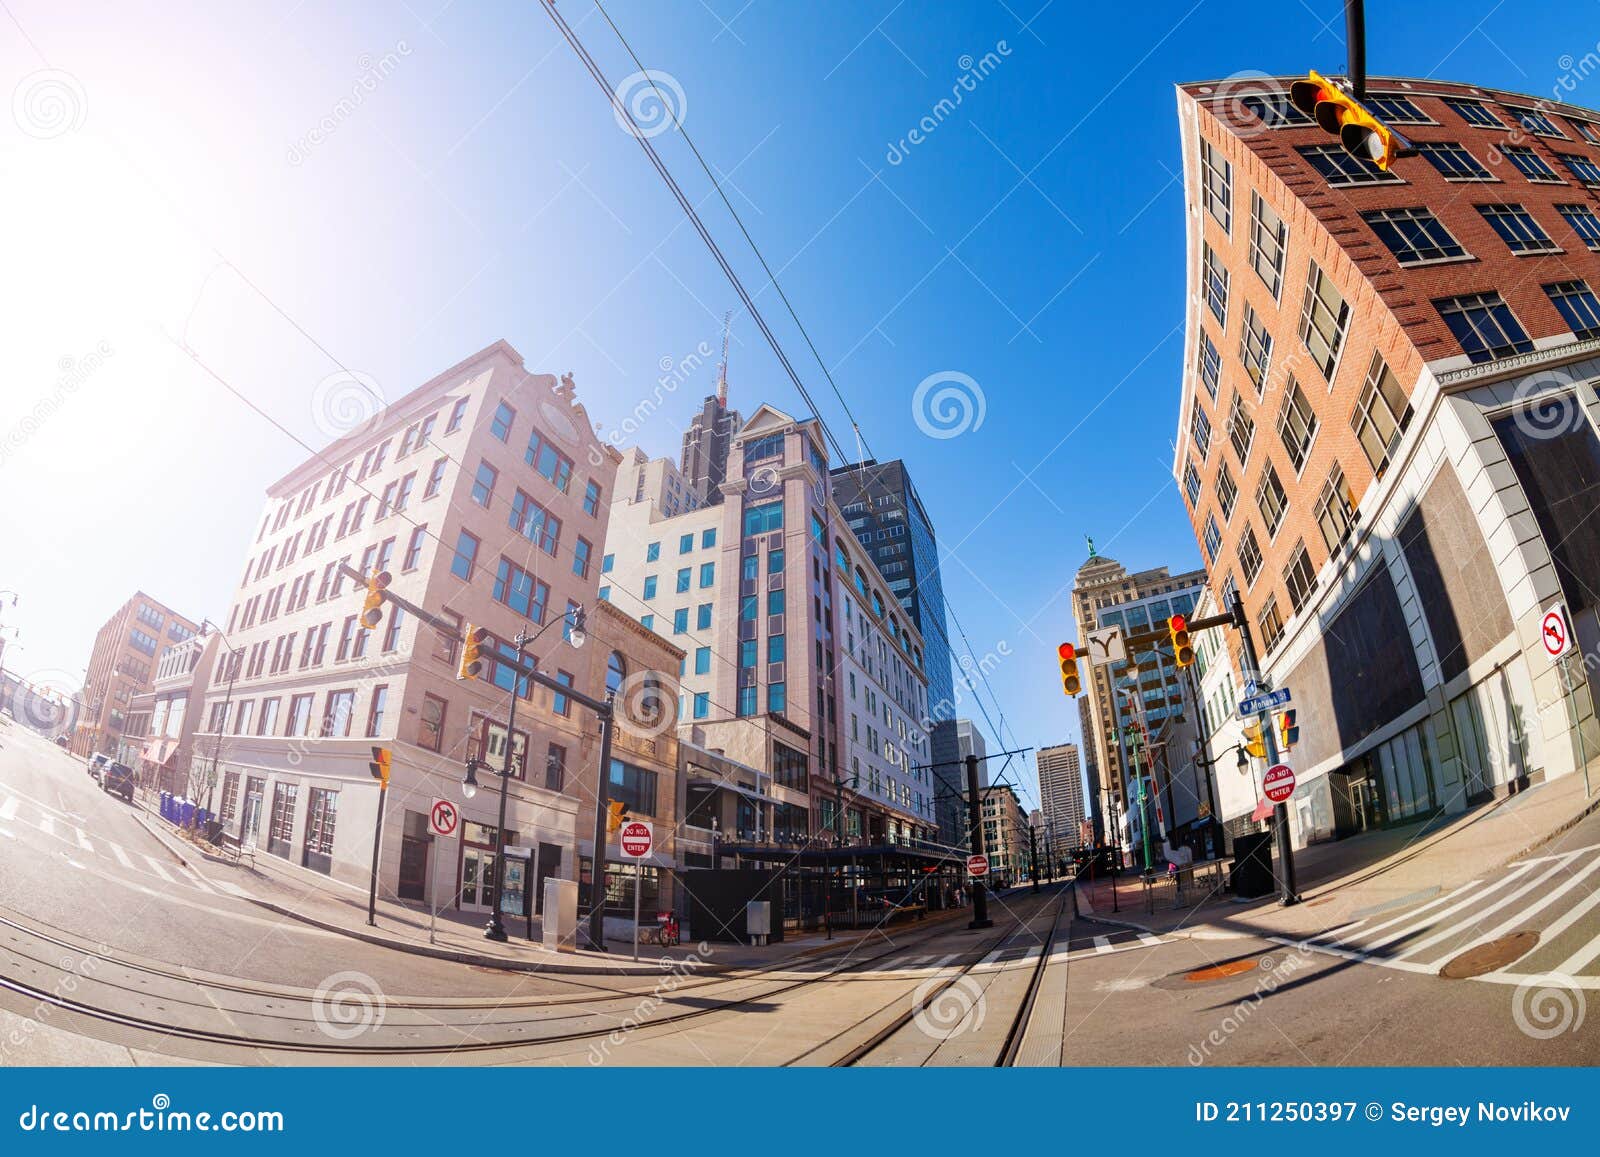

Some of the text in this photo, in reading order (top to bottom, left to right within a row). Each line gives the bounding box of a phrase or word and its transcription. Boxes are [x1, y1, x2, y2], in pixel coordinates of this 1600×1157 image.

[1266, 769, 1290, 781] DO NOT
[1271, 787, 1290, 798] ENTER
[627, 844, 645, 852] ENTER
